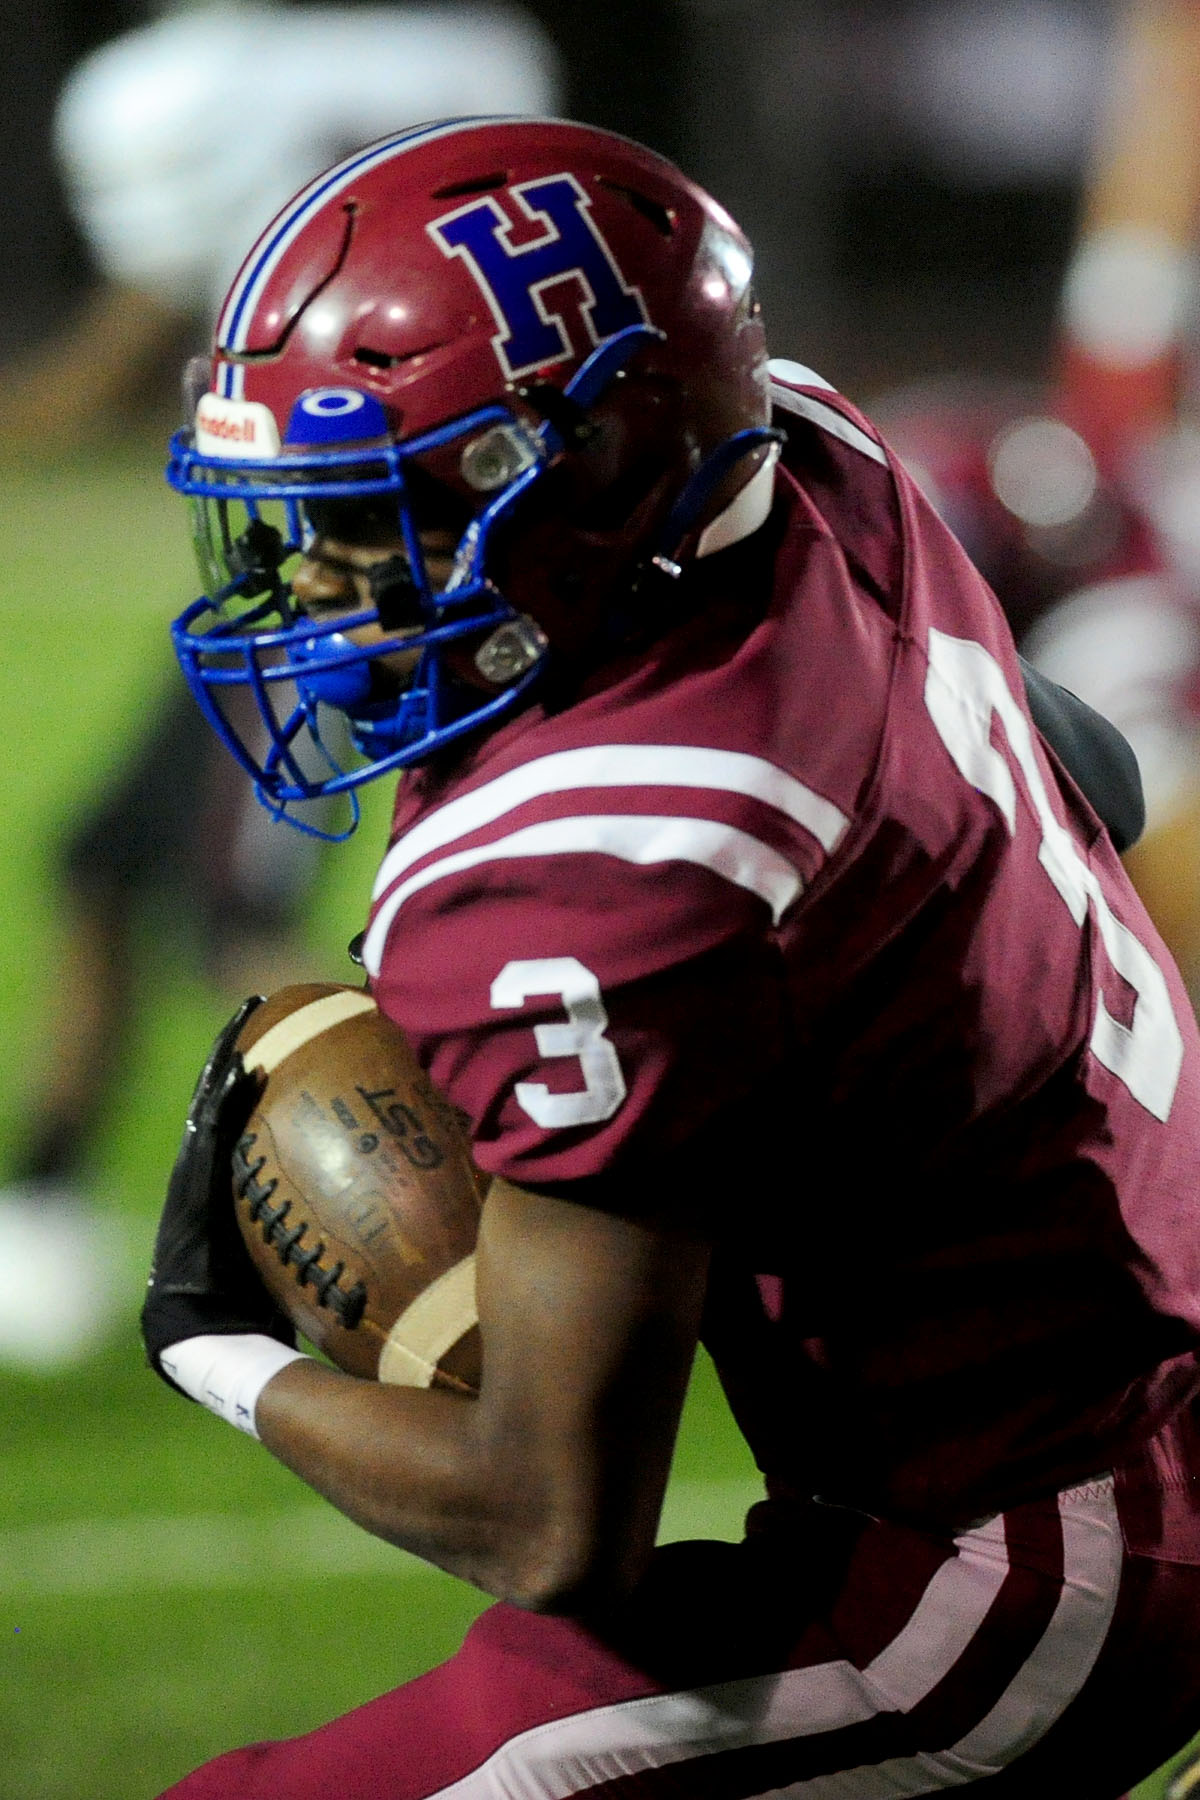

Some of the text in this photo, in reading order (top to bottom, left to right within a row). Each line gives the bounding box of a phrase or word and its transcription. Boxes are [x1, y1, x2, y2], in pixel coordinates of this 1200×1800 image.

[427, 172, 650, 379] H
[924, 626, 1184, 1124] 3
[355, 1085, 443, 1169] GST
[490, 957, 626, 1128] 3
